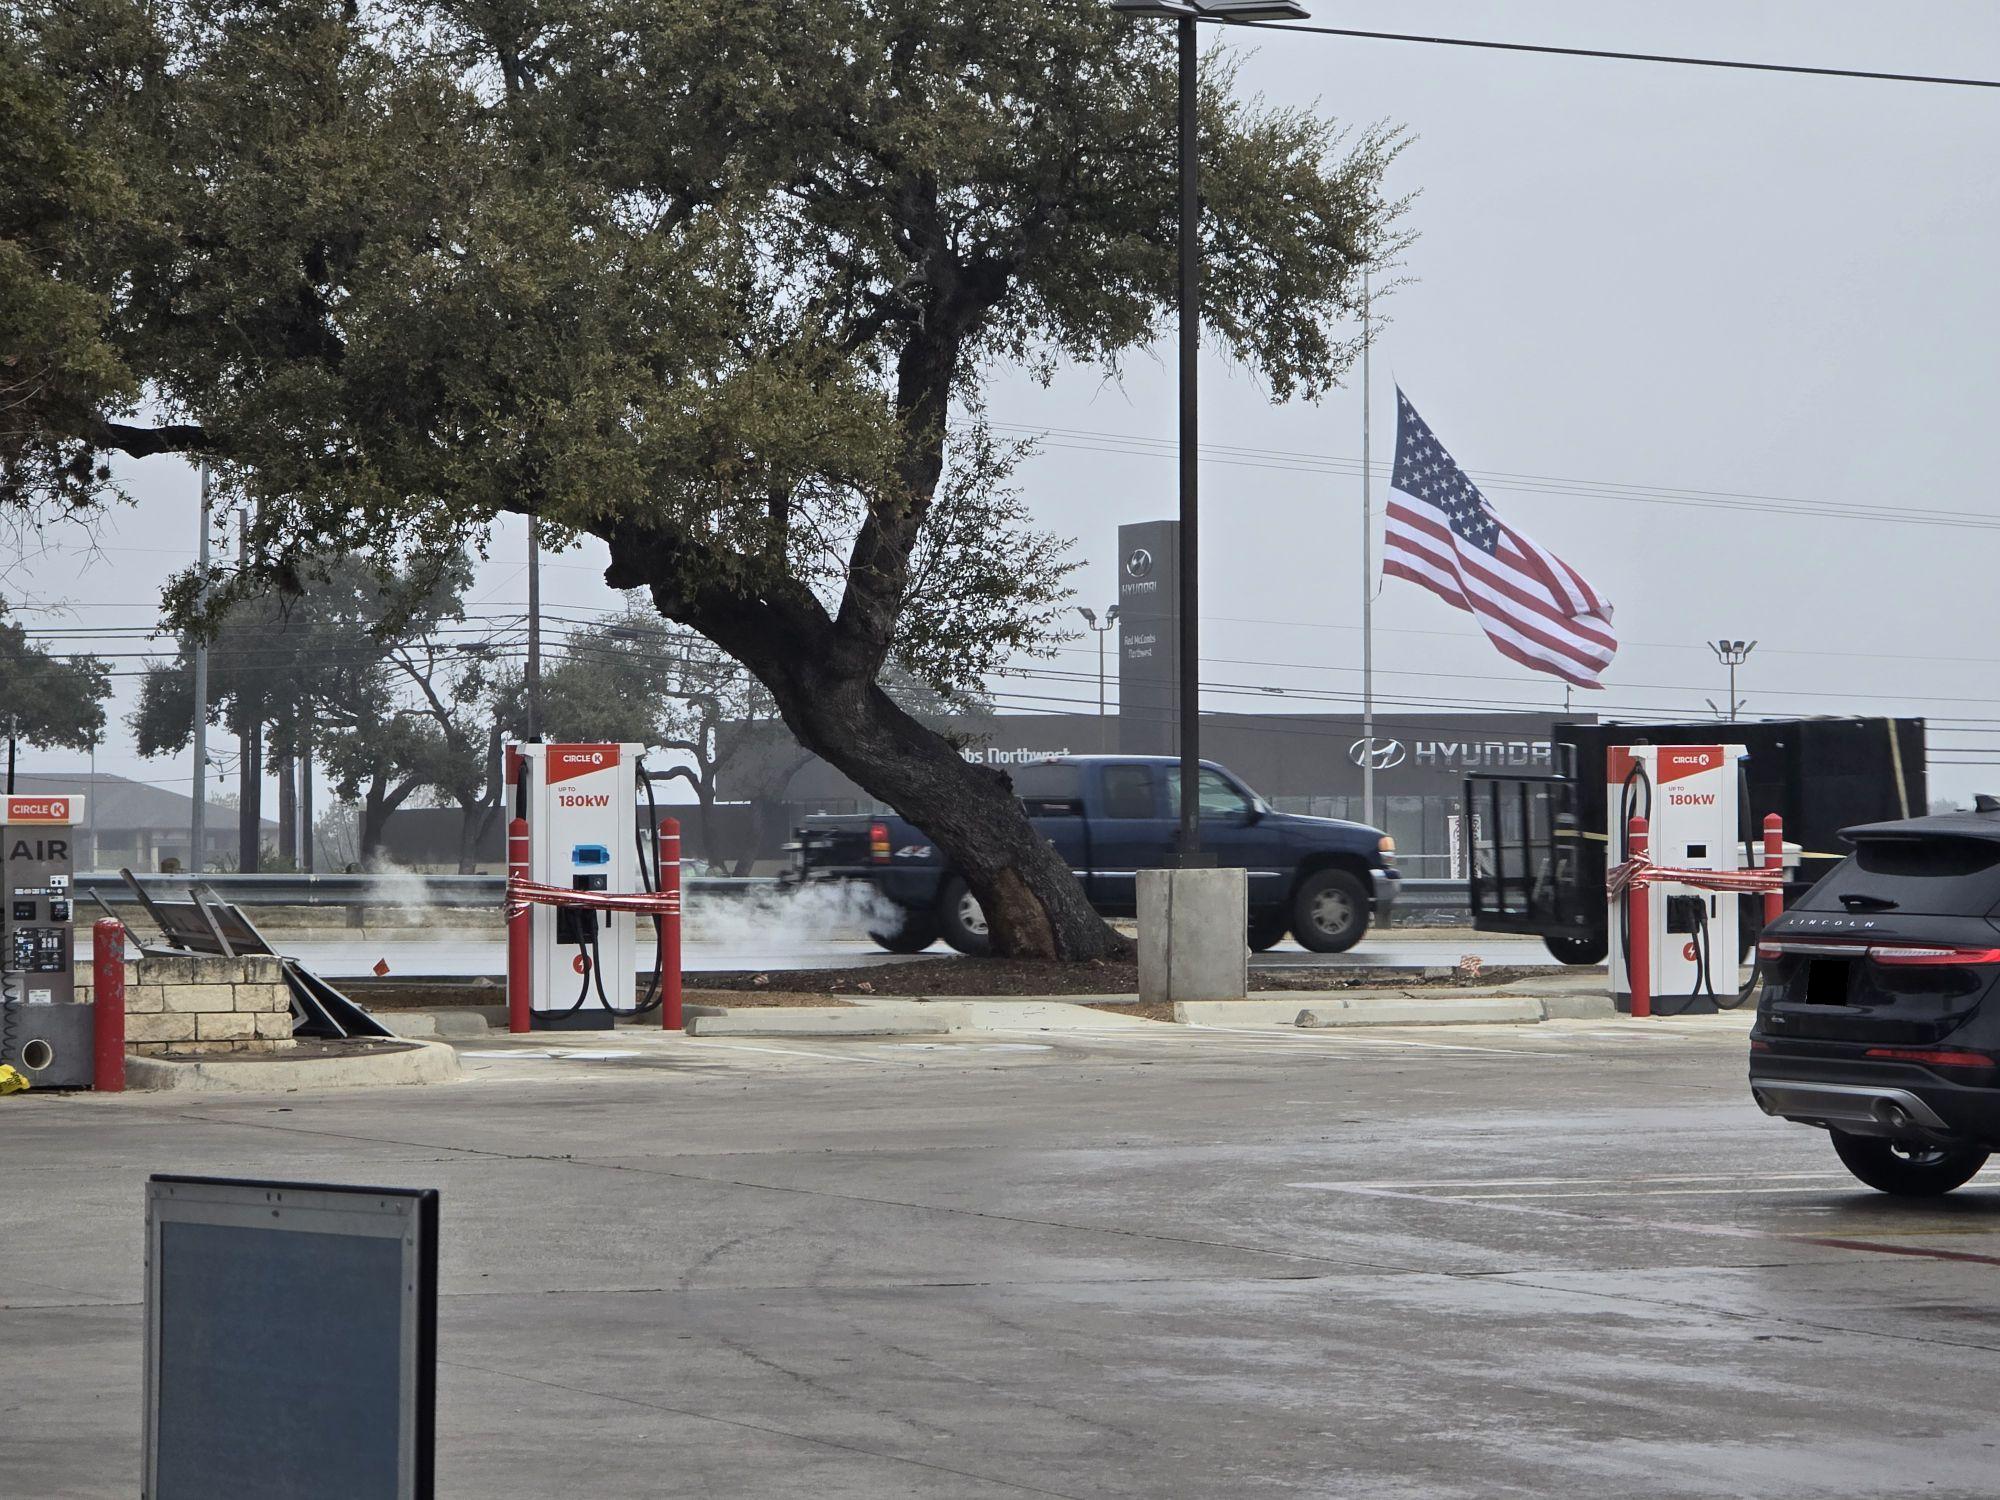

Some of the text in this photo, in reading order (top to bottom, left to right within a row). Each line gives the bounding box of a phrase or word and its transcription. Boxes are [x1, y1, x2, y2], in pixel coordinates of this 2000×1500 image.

[1122, 582, 1157, 596] HYUNDAI
[562, 753, 603, 764] CIRCLE K
[959, 748, 1070, 764] bs Northwest
[1416, 741, 1552, 766] HYUNDA
[1672, 754, 1709, 765] CIRCLE K
[559, 795, 610, 807] 180kW
[1669, 794, 1715, 805] 180kW
[12, 802, 65, 817] CIRCLE K
[9, 840, 68, 861] AIR
[1789, 919, 1875, 928] LINCOLN
